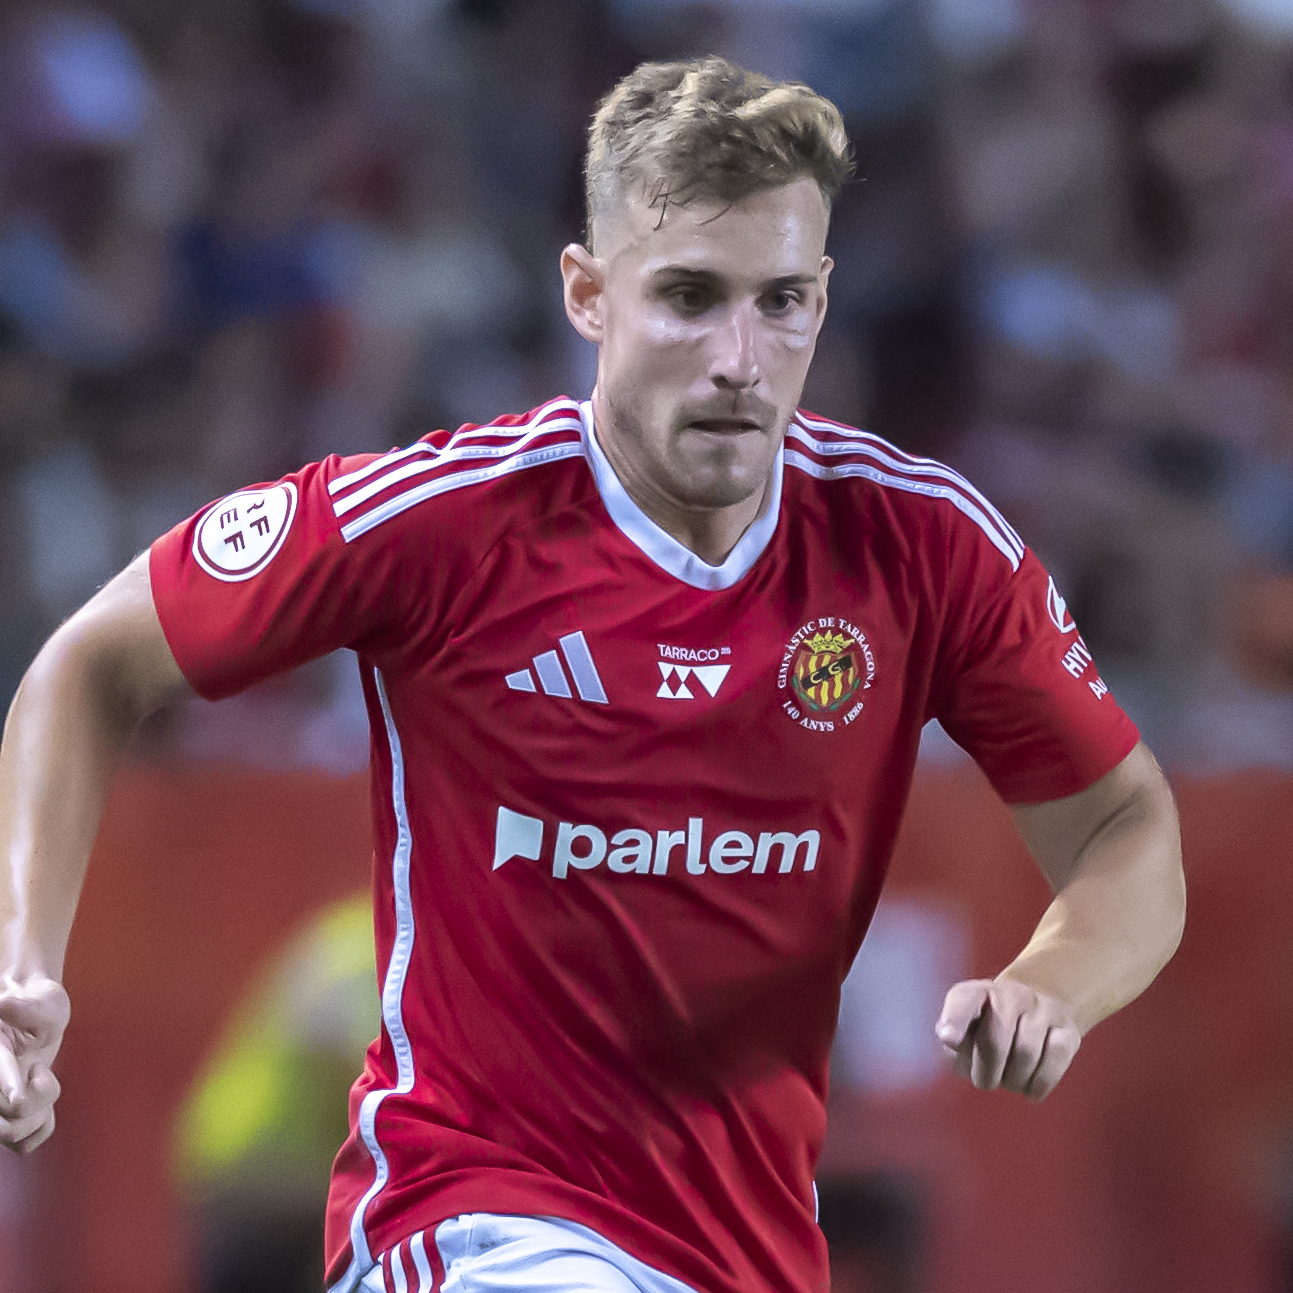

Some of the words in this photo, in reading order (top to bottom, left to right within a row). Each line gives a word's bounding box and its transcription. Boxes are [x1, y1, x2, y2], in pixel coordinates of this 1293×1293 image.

[656, 643, 720, 662] TARRACO
[818, 617, 836, 629] DE
[838, 618, 875, 690] TARRAGONA
[798, 717, 836, 733] ANYS
[552, 816, 821, 880] parlem
